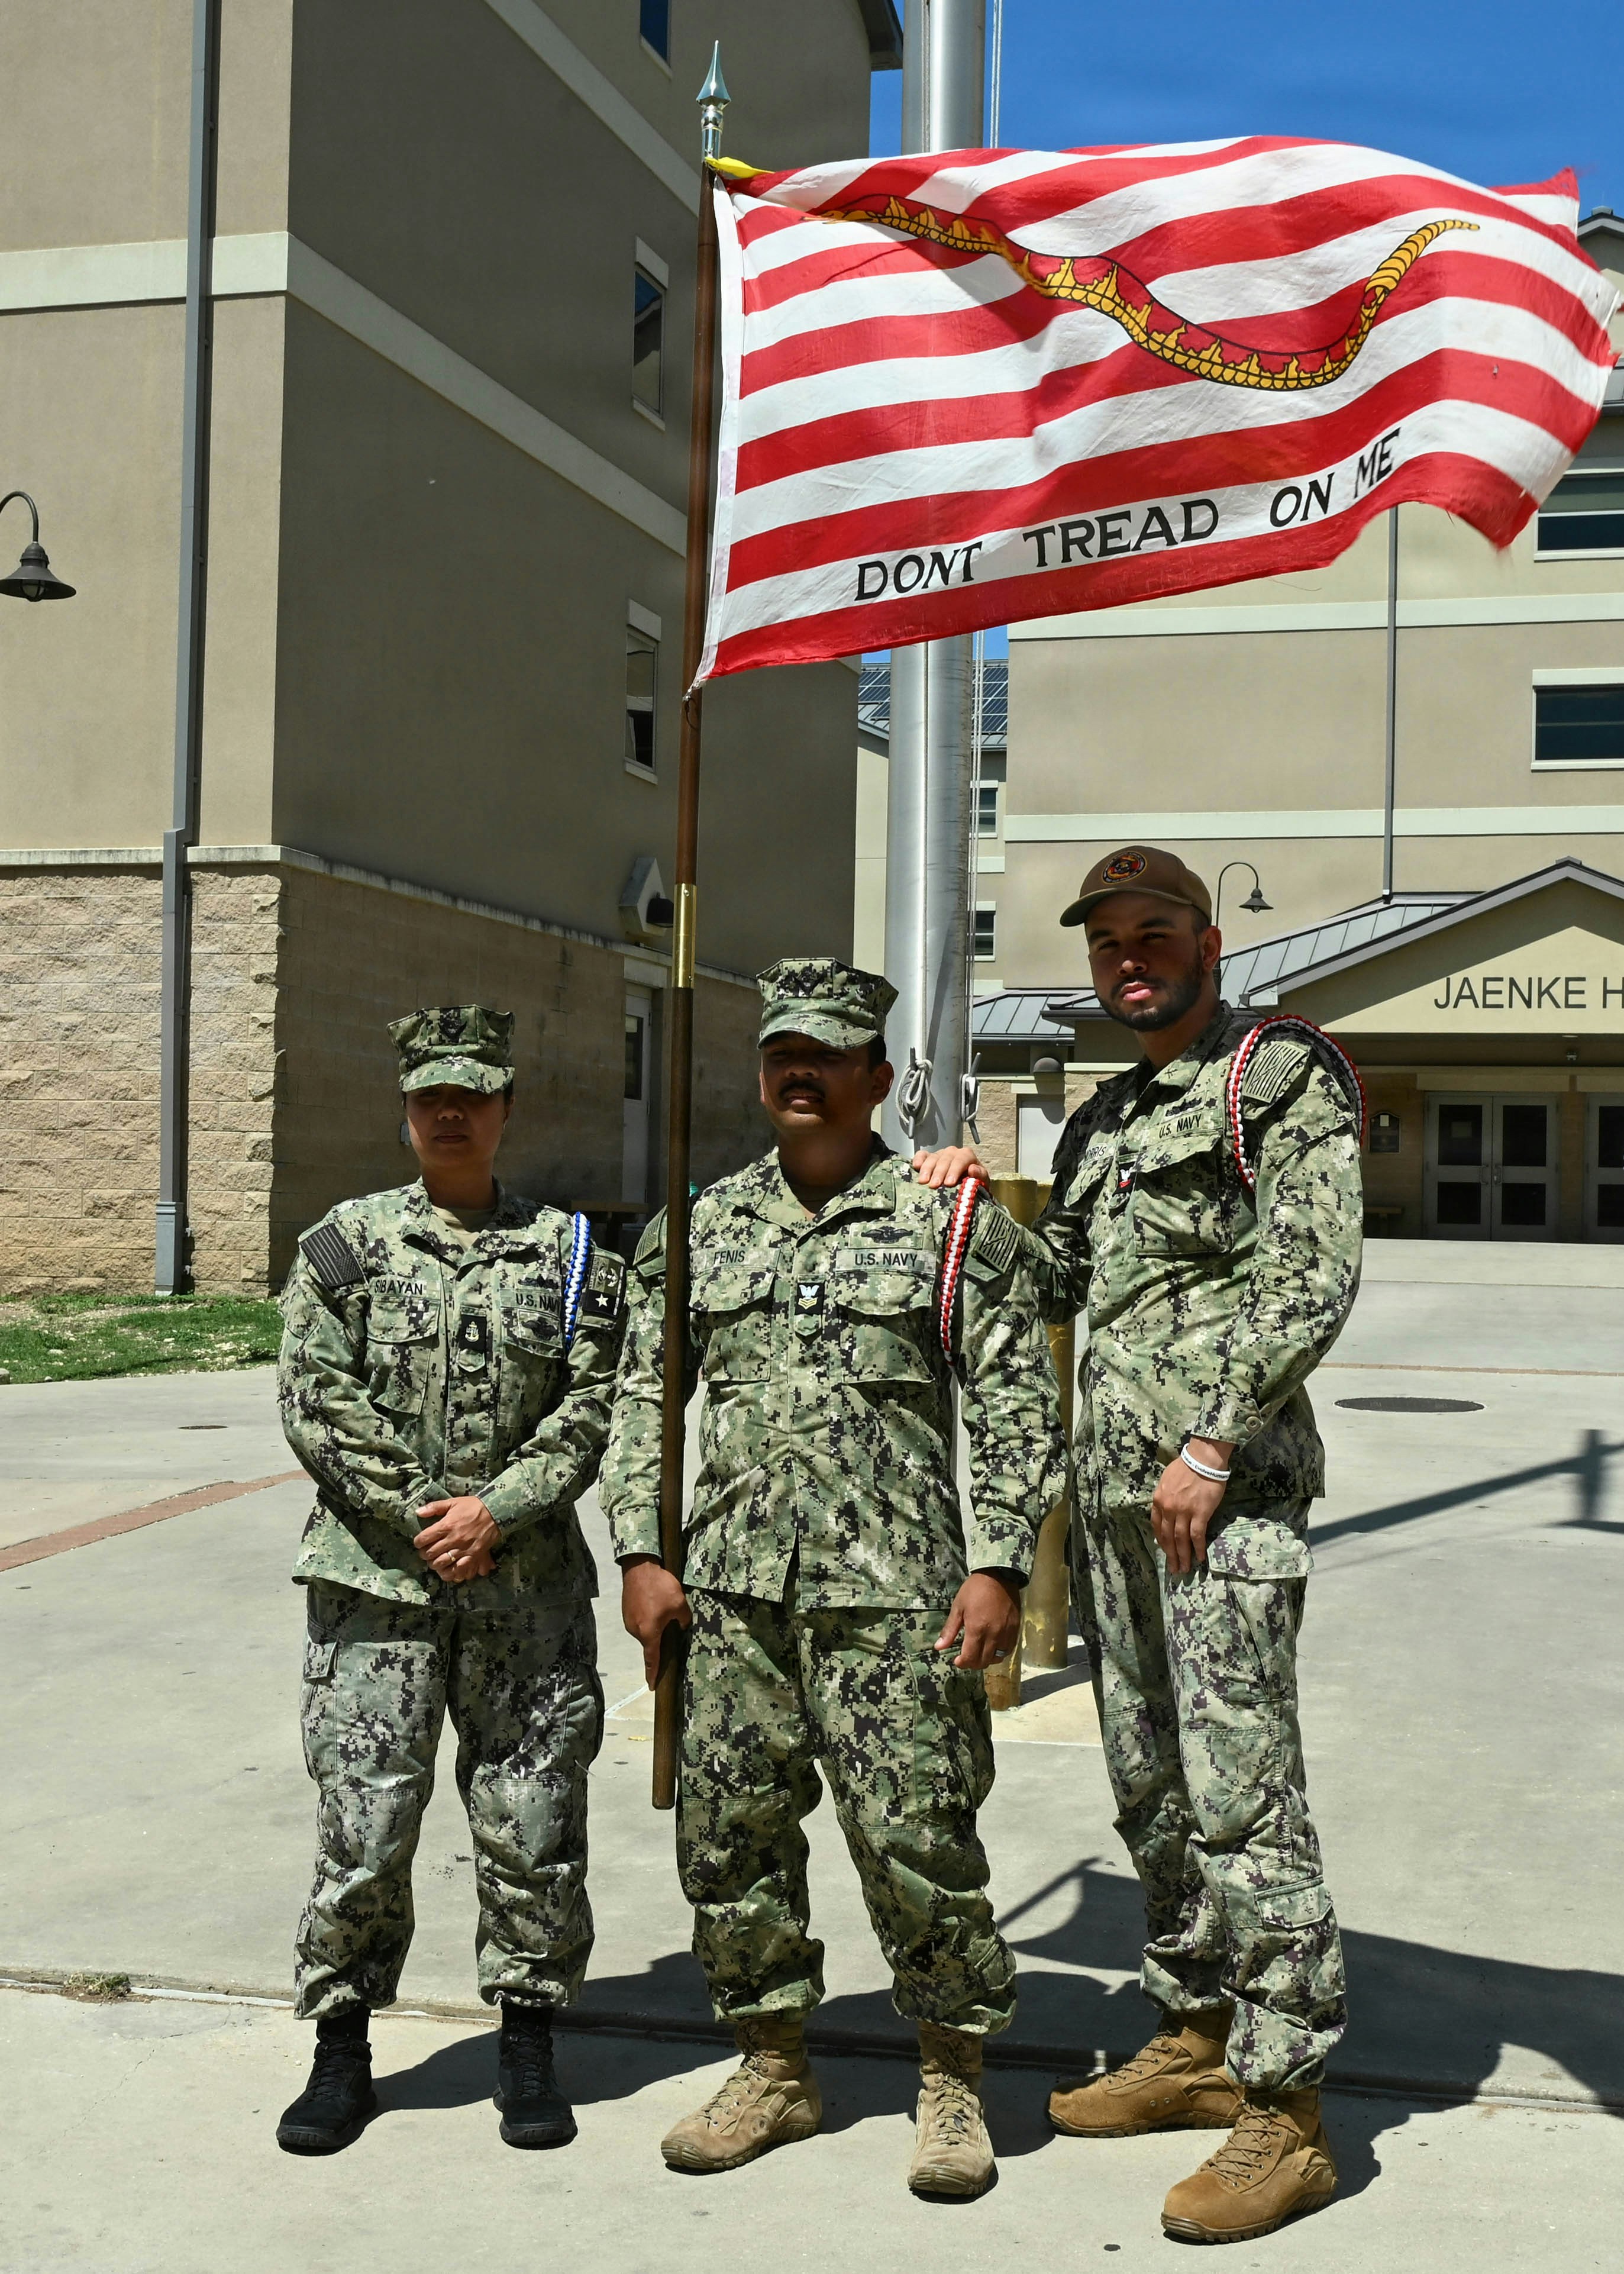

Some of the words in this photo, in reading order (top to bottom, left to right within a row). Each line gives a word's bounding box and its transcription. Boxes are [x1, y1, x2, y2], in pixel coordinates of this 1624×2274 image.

[854, 541, 983, 602] DONT
[1022, 498, 1219, 567] TREAD
[1270, 472, 1335, 527] ON
[1354, 427, 1401, 499] ME
[1434, 977, 1587, 1008] JAENKE
[1603, 977, 1624, 1008] H
[1159, 1123, 1171, 1138] U.S.
[1176, 1114, 1202, 1133] NAVY
[713, 1250, 745, 1264] FENIS
[855, 1253, 879, 1265] U.S.
[883, 1253, 918, 1267] NAVY
[374, 1279, 423, 1295] SIBAYAN
[516, 1293, 537, 1308] U.S.
